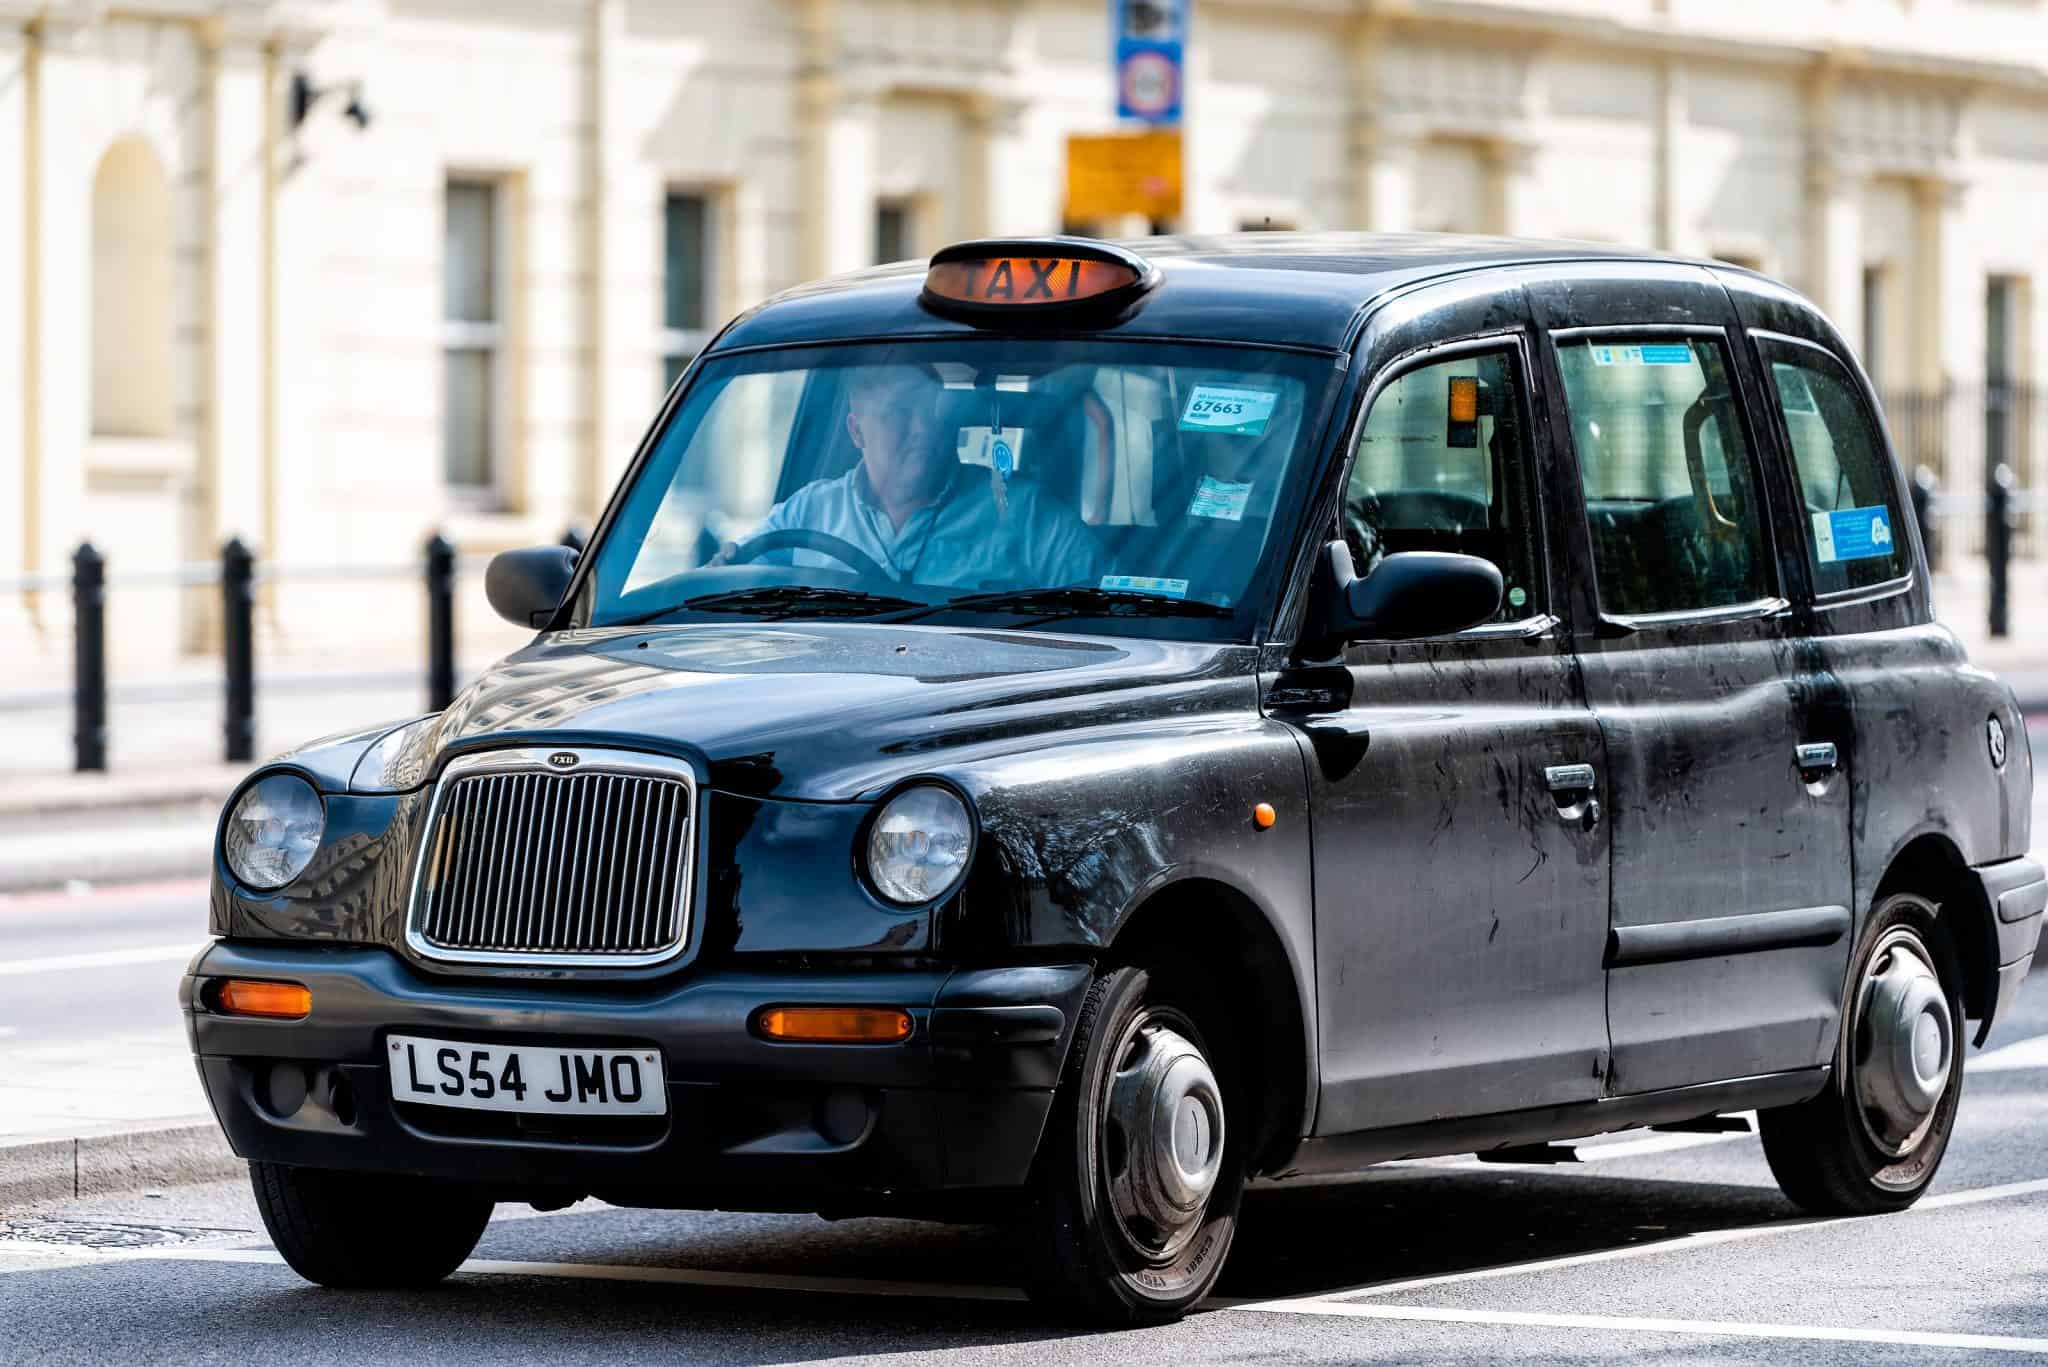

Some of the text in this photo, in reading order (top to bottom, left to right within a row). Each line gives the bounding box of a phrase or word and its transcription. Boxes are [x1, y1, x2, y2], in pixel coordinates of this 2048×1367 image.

[962, 259, 1081, 299] TAXI
[1192, 400, 1243, 415] 67663
[407, 1044, 642, 1103] LS54 JMO
